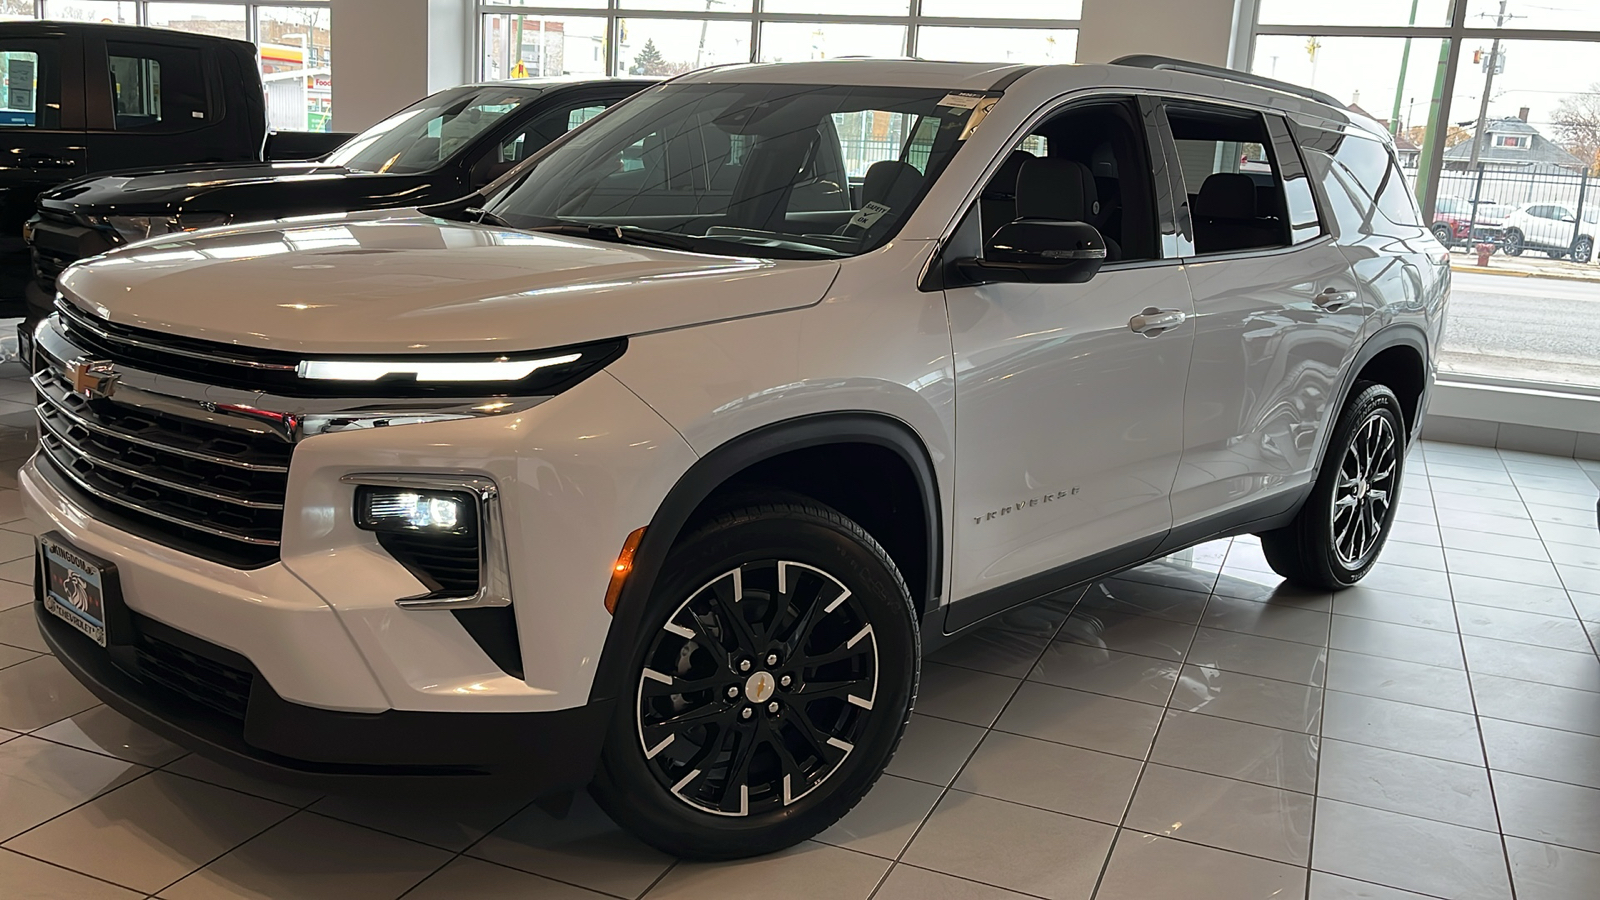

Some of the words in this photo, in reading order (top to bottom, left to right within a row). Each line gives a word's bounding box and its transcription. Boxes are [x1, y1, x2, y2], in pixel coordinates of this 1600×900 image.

[315, 78, 332, 87] Food
[866, 204, 887, 214] SAFETY
[973, 486, 1080, 525] TRAVERSE
[52, 545, 86, 571] KINGDOM
[58, 607, 93, 634] CHEVROLET
